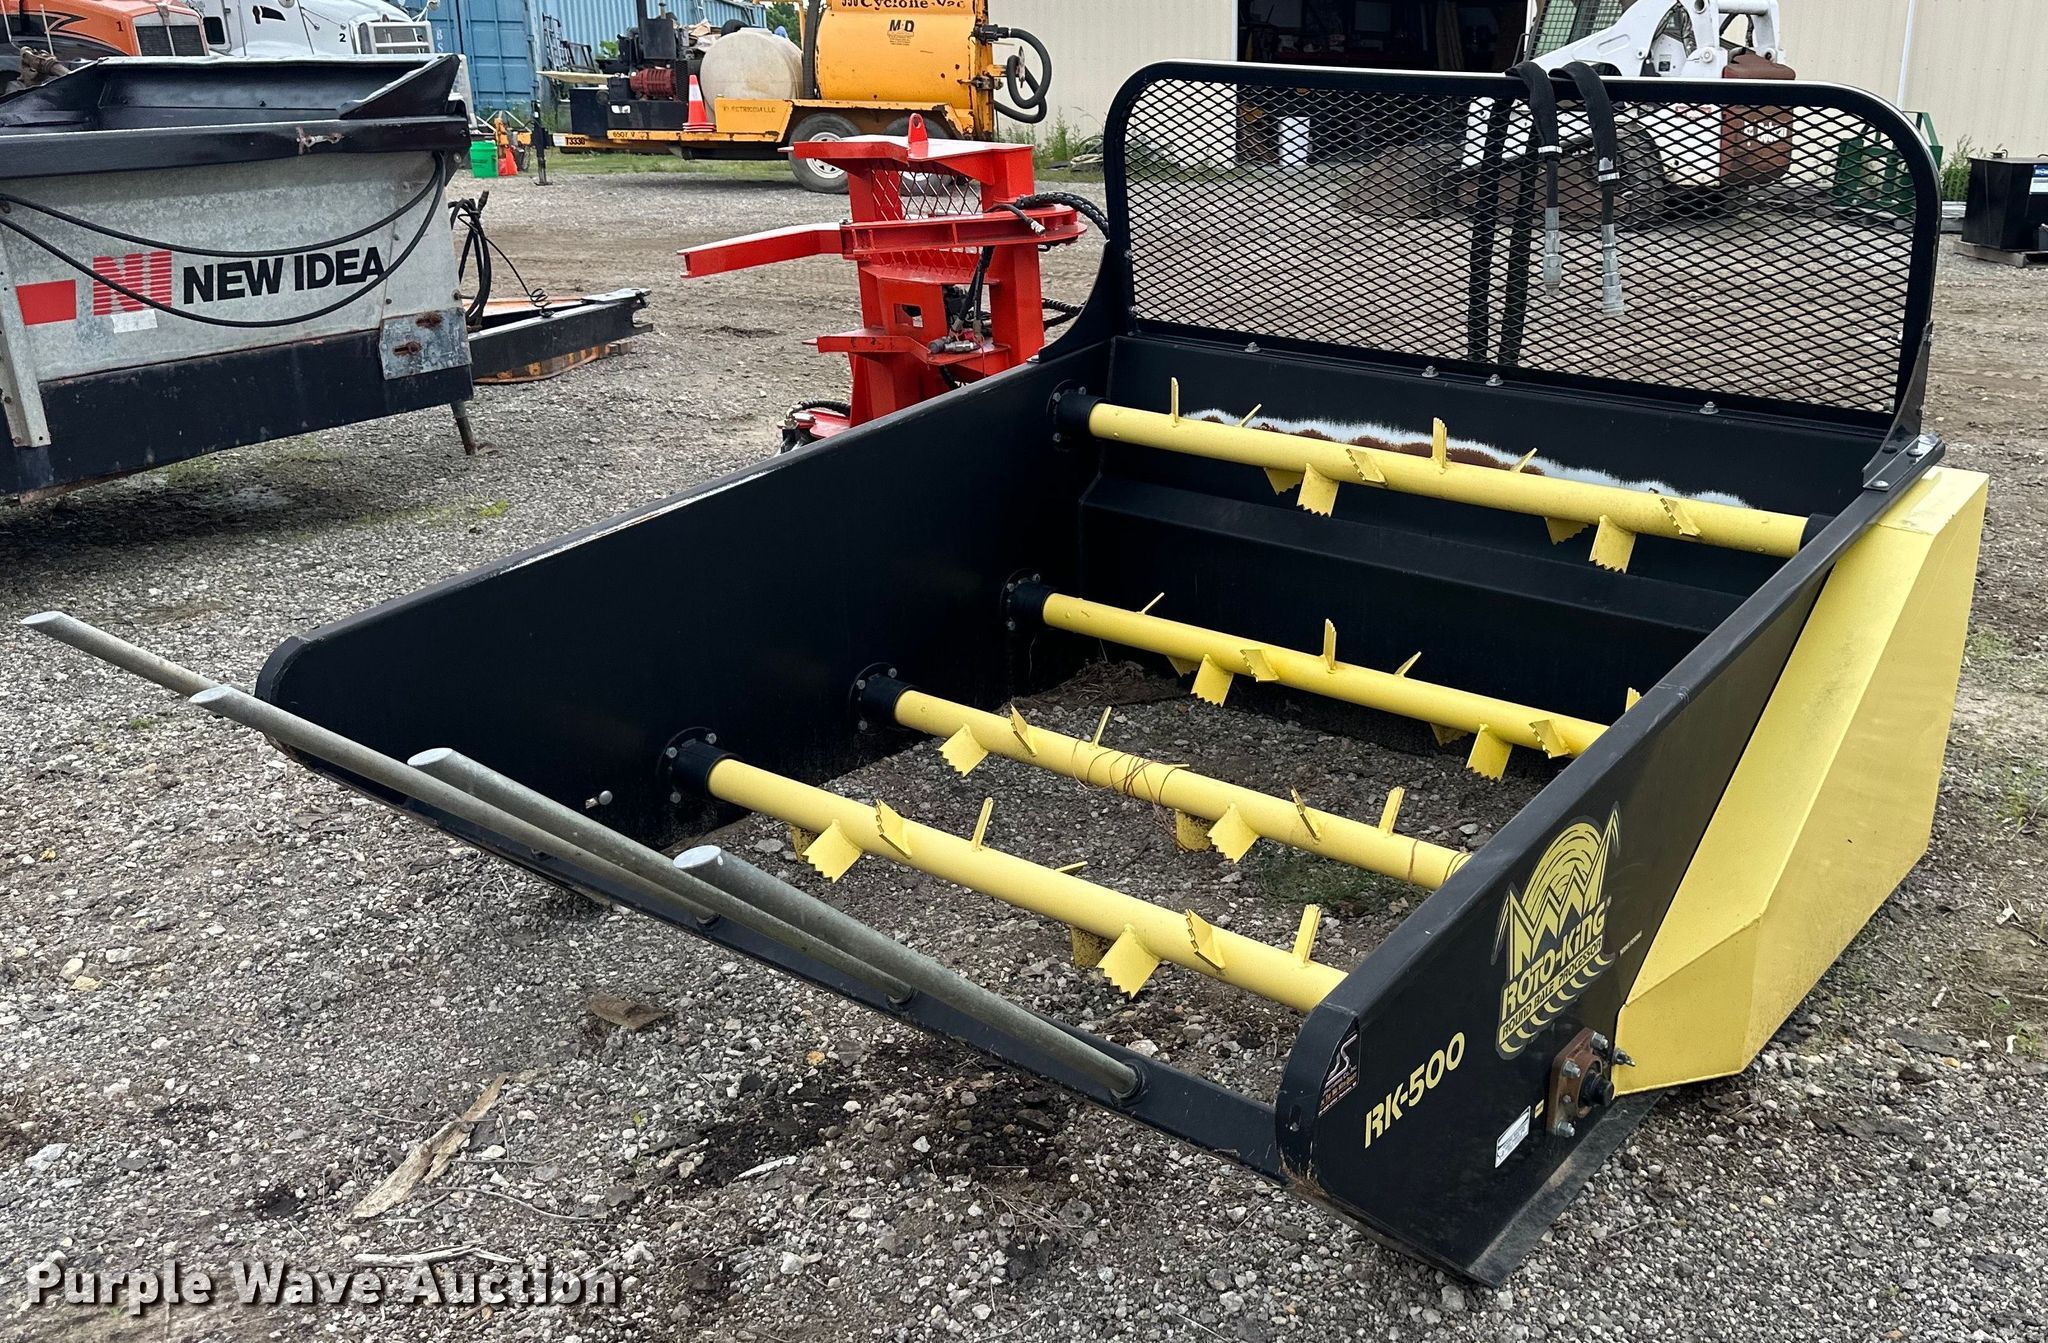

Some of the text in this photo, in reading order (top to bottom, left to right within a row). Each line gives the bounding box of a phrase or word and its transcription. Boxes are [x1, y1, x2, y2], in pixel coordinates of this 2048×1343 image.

[116, 21, 124, 33] 1
[339, 33, 347, 43] 2
[183, 257, 284, 305] NEW
[294, 246, 385, 292] IDEA
[1502, 1003, 1533, 1039] ROUND
[1533, 981, 1555, 1010] BALE
[1558, 937, 1603, 986] PROCESSOR
[1364, 1031, 1466, 1149] RK-500
